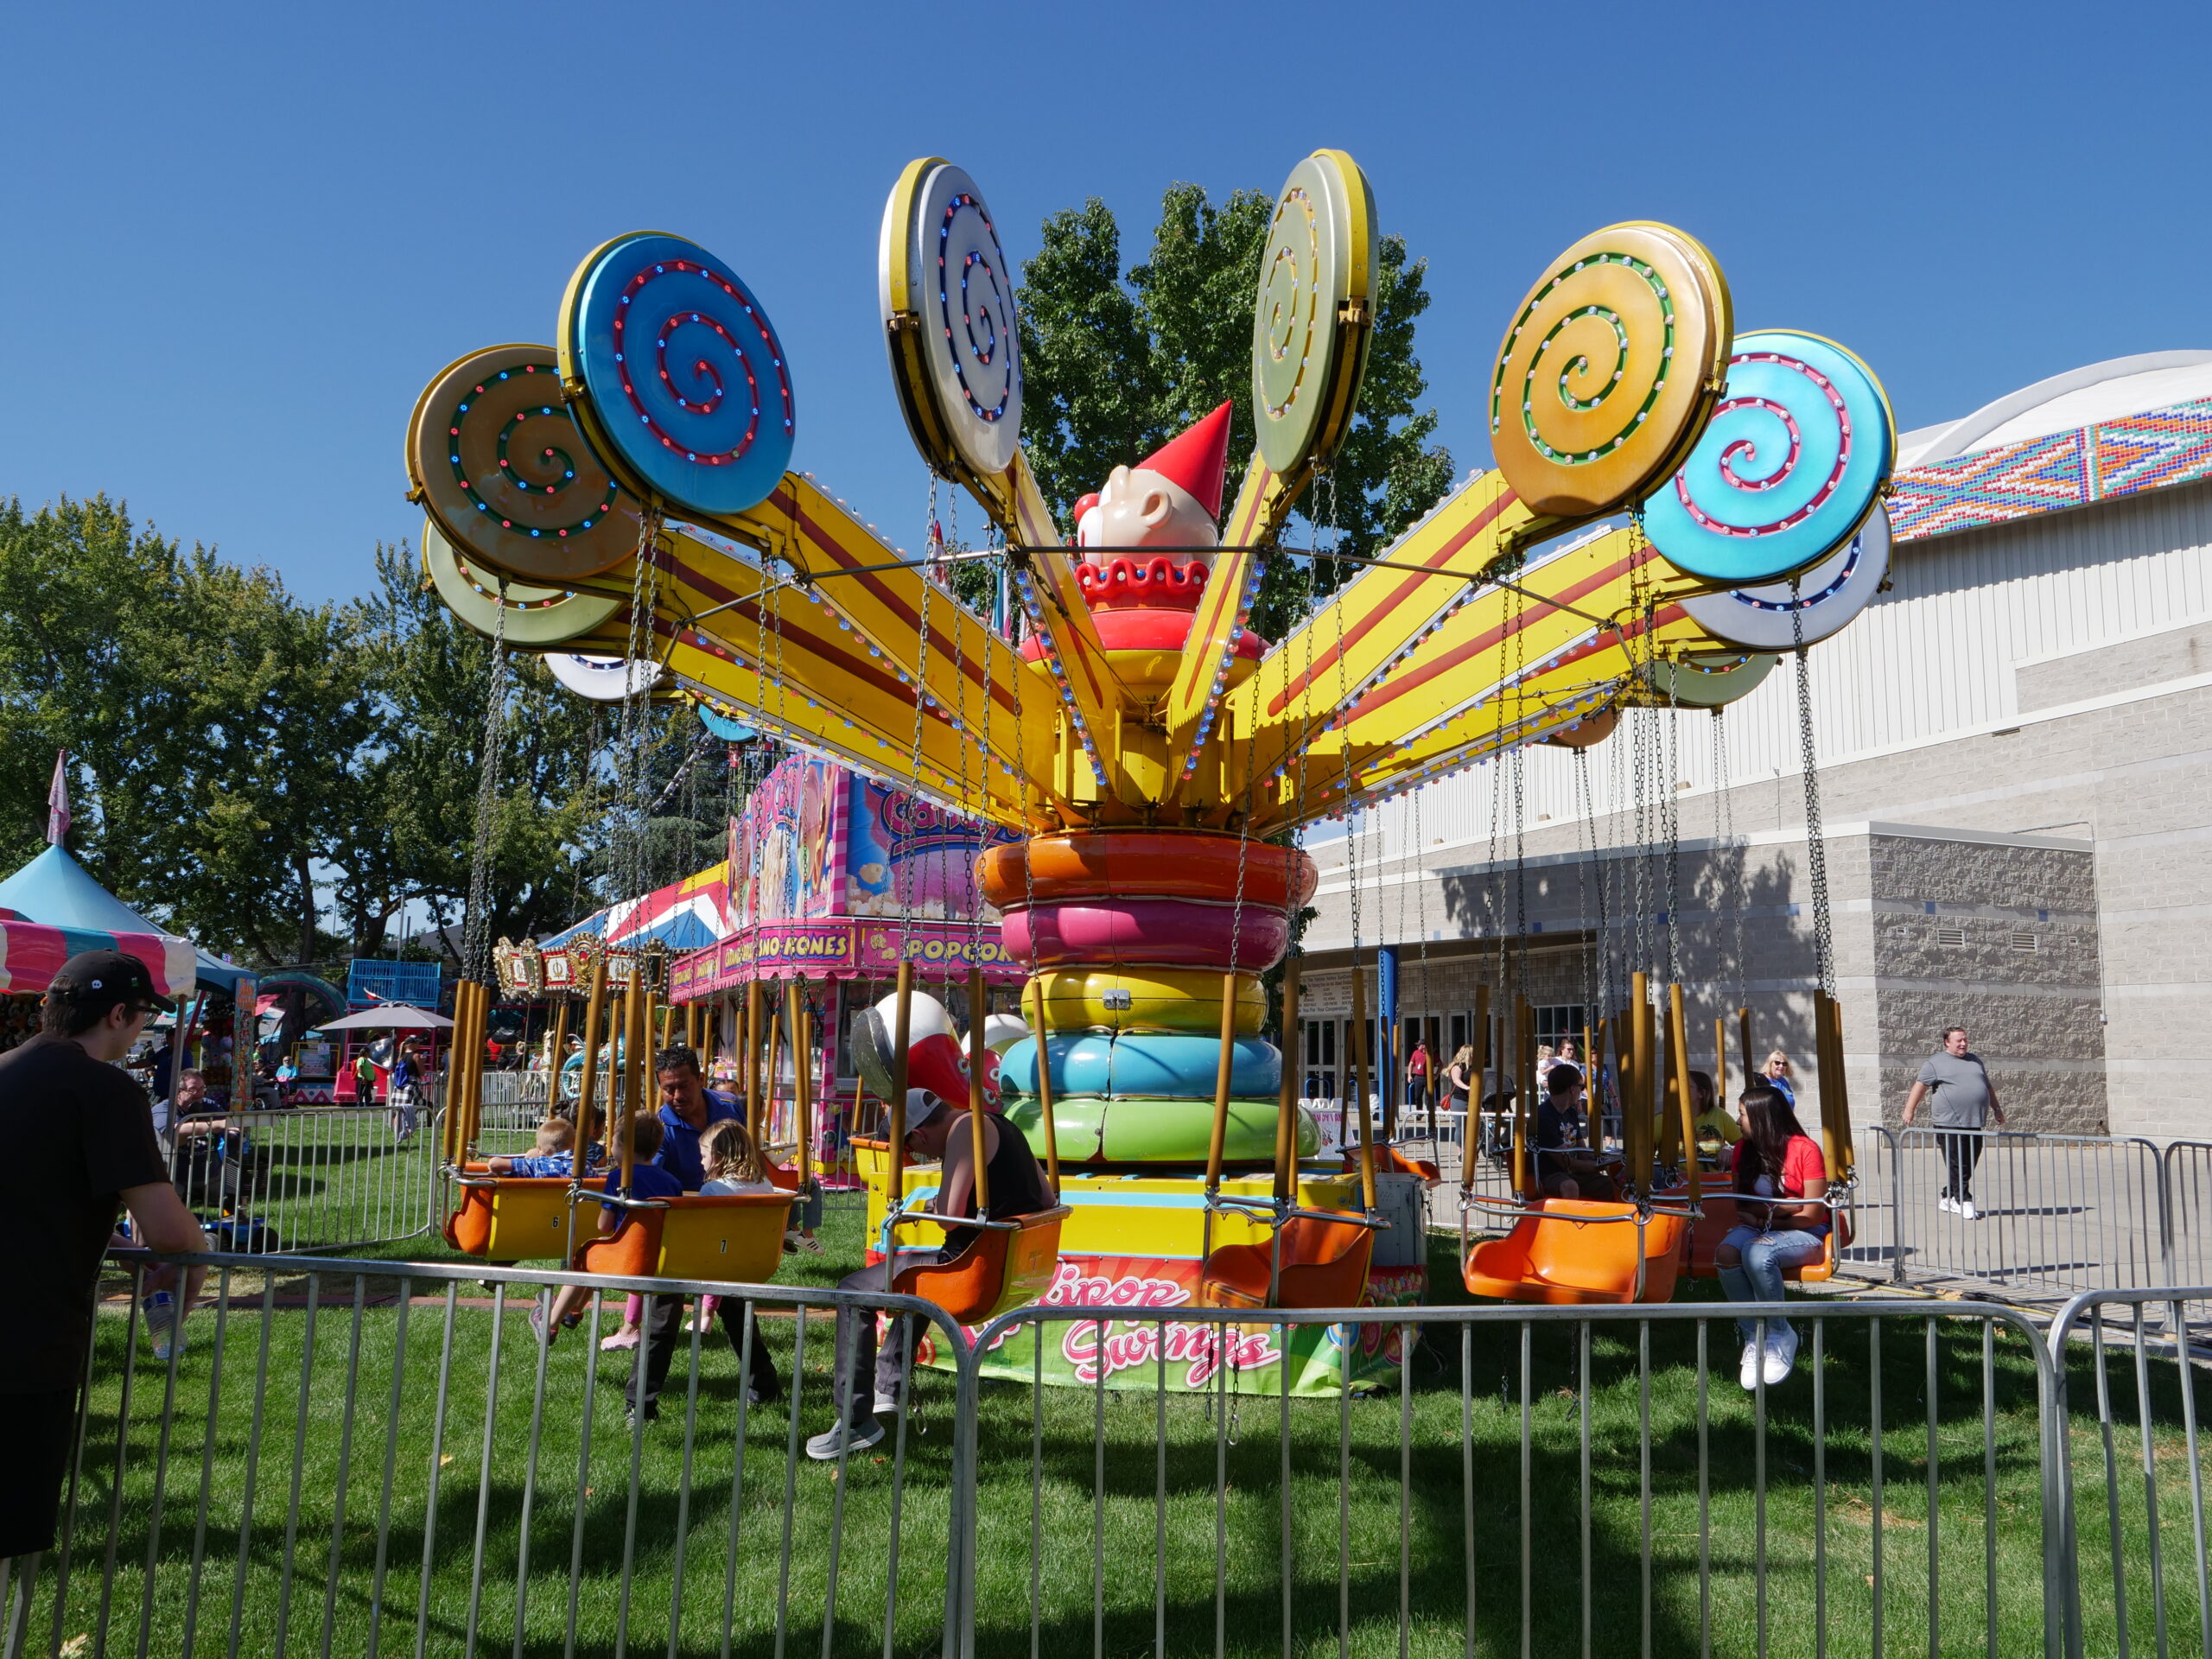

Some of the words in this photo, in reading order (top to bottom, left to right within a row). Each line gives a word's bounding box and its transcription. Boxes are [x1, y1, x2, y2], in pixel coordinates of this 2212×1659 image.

[552, 1217, 558, 1227] 6
[721, 1239, 727, 1253] 7
[1063, 1319, 1281, 1388] Swngs
